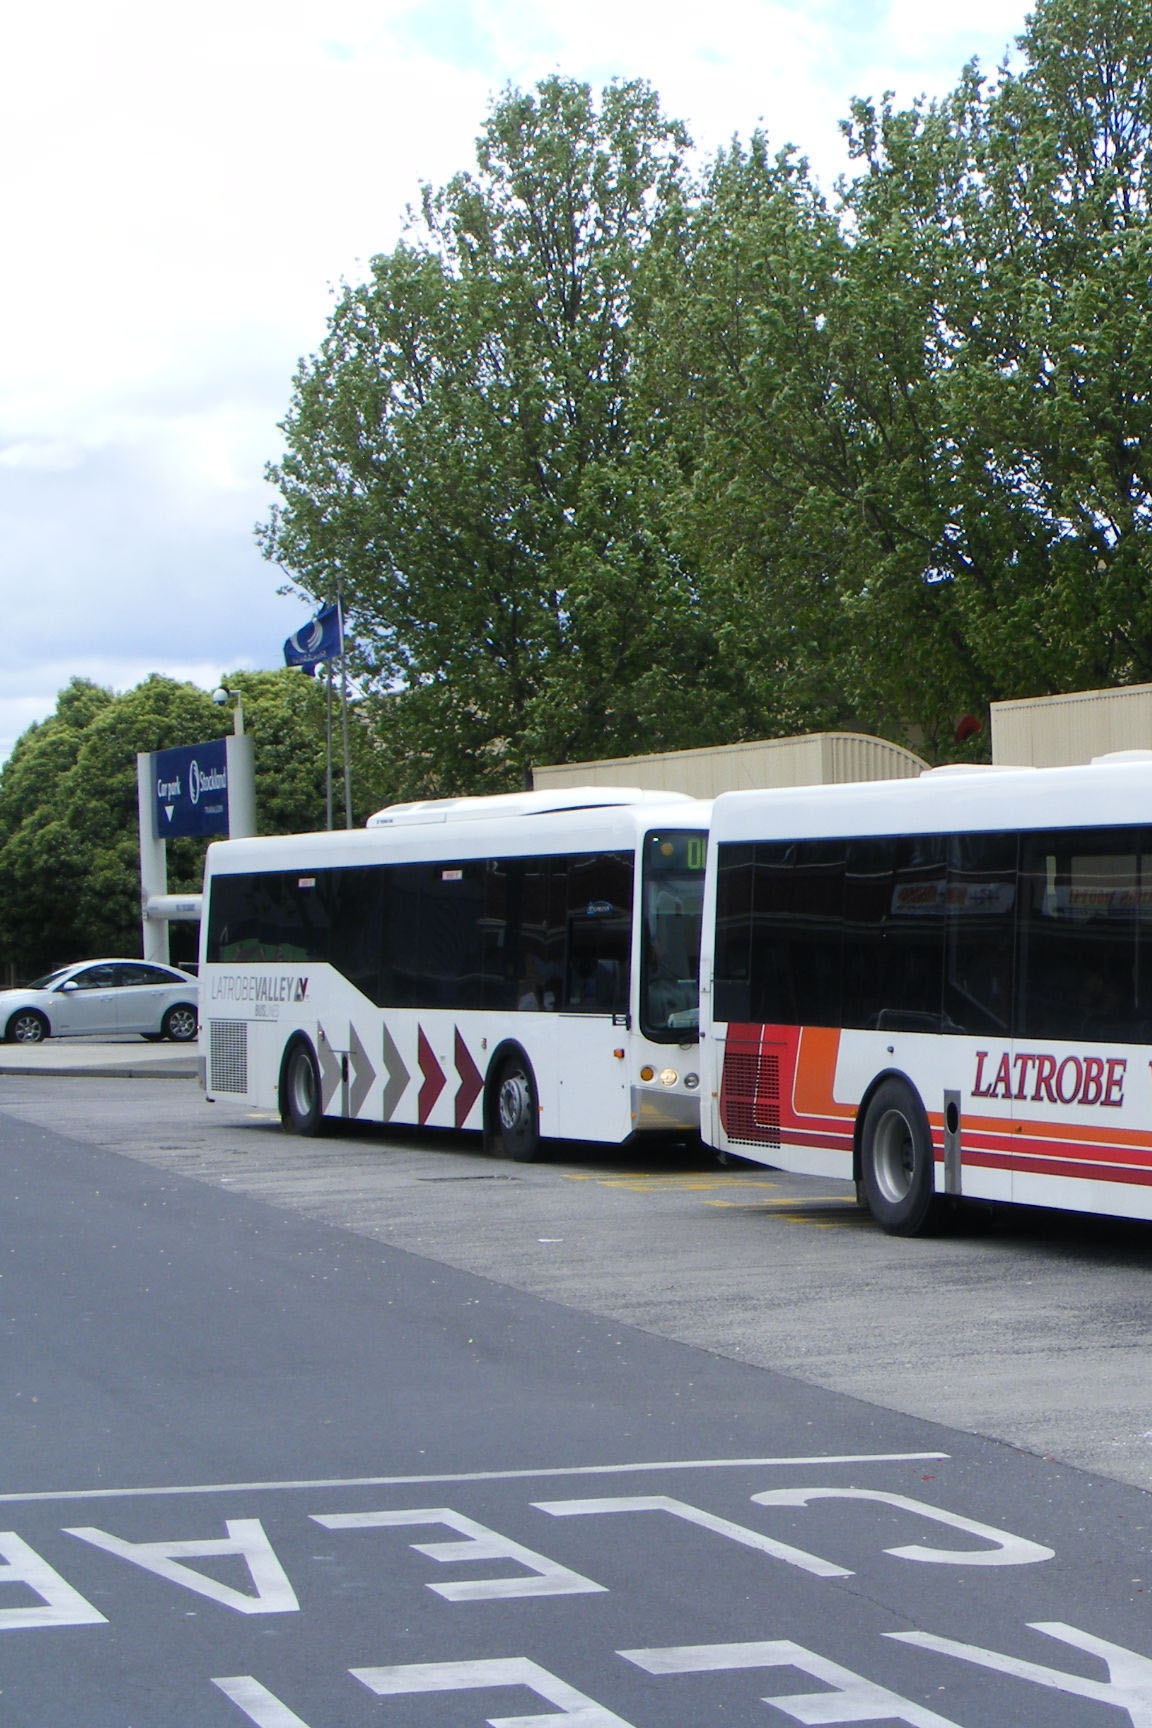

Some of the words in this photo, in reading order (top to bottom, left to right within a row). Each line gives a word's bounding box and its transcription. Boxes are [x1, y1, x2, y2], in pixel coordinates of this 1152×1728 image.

[168, 775, 181, 802] park
[200, 766, 226, 792] Stockland
[212, 976, 294, 1002] LATROBEVALLEY
[970, 1050, 1128, 1108] LATROBE
